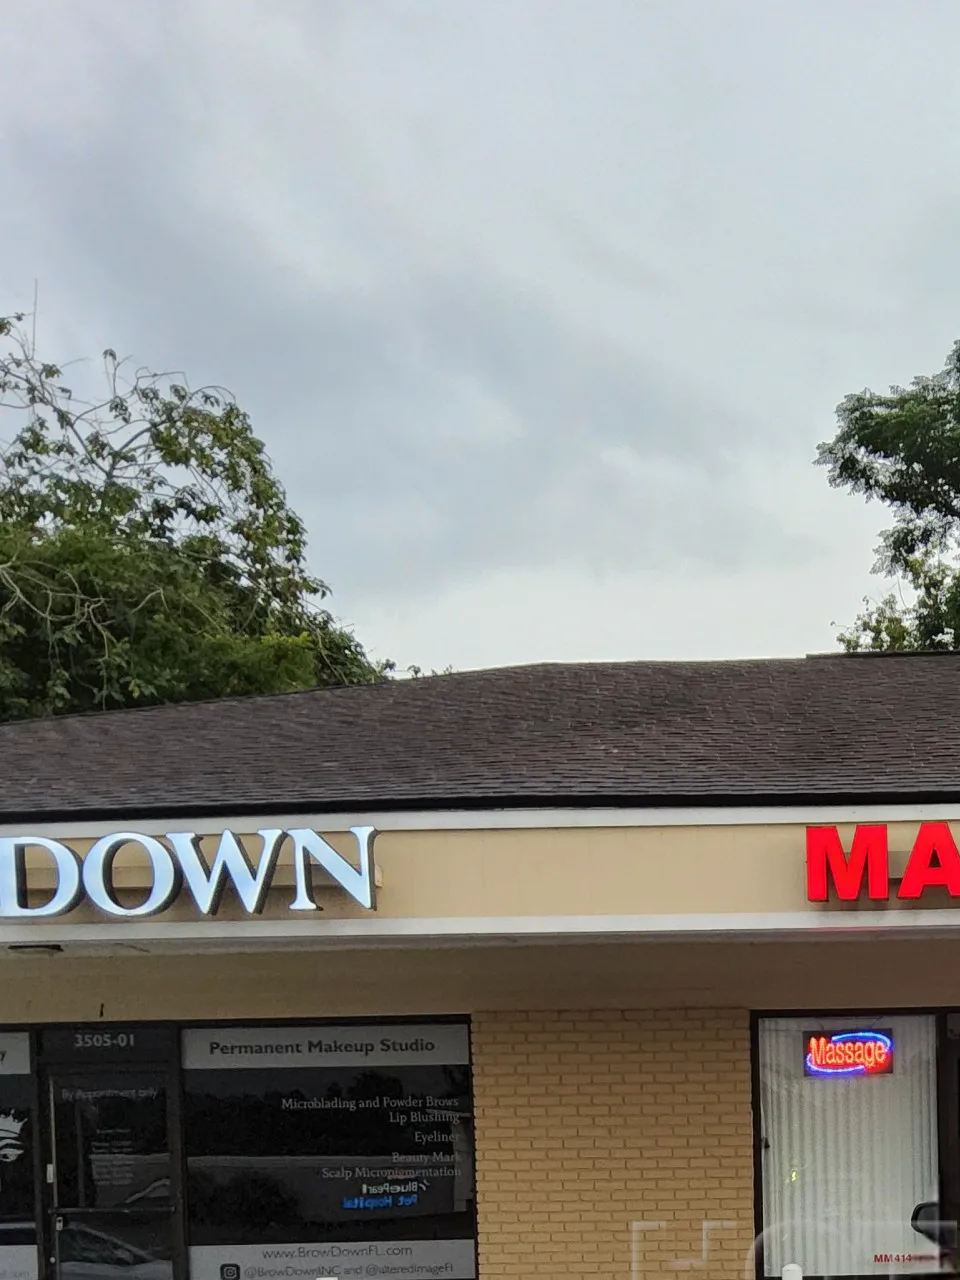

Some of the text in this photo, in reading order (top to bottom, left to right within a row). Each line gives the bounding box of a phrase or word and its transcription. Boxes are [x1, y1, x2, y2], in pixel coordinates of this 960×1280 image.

[0, 826, 376, 917] DOWN
[74, 1033, 135, 1047] 3505-01
[209, 1038, 435, 1056] Permanent Makeup Studio
[809, 1036, 885, 1067] Massage
[281, 1095, 460, 1112] Microblading and Powder Brows
[388, 1110, 461, 1126] Lip Blushing
[414, 1131, 461, 1145] Eyeliner
[391, 1151, 430, 1165] Beauty
[322, 1166, 462, 1181] Scalp Micropigmentation
[261, 1245, 413, 1259] www.BrowDownFL.com
[343, 1264, 363, 1276] and
